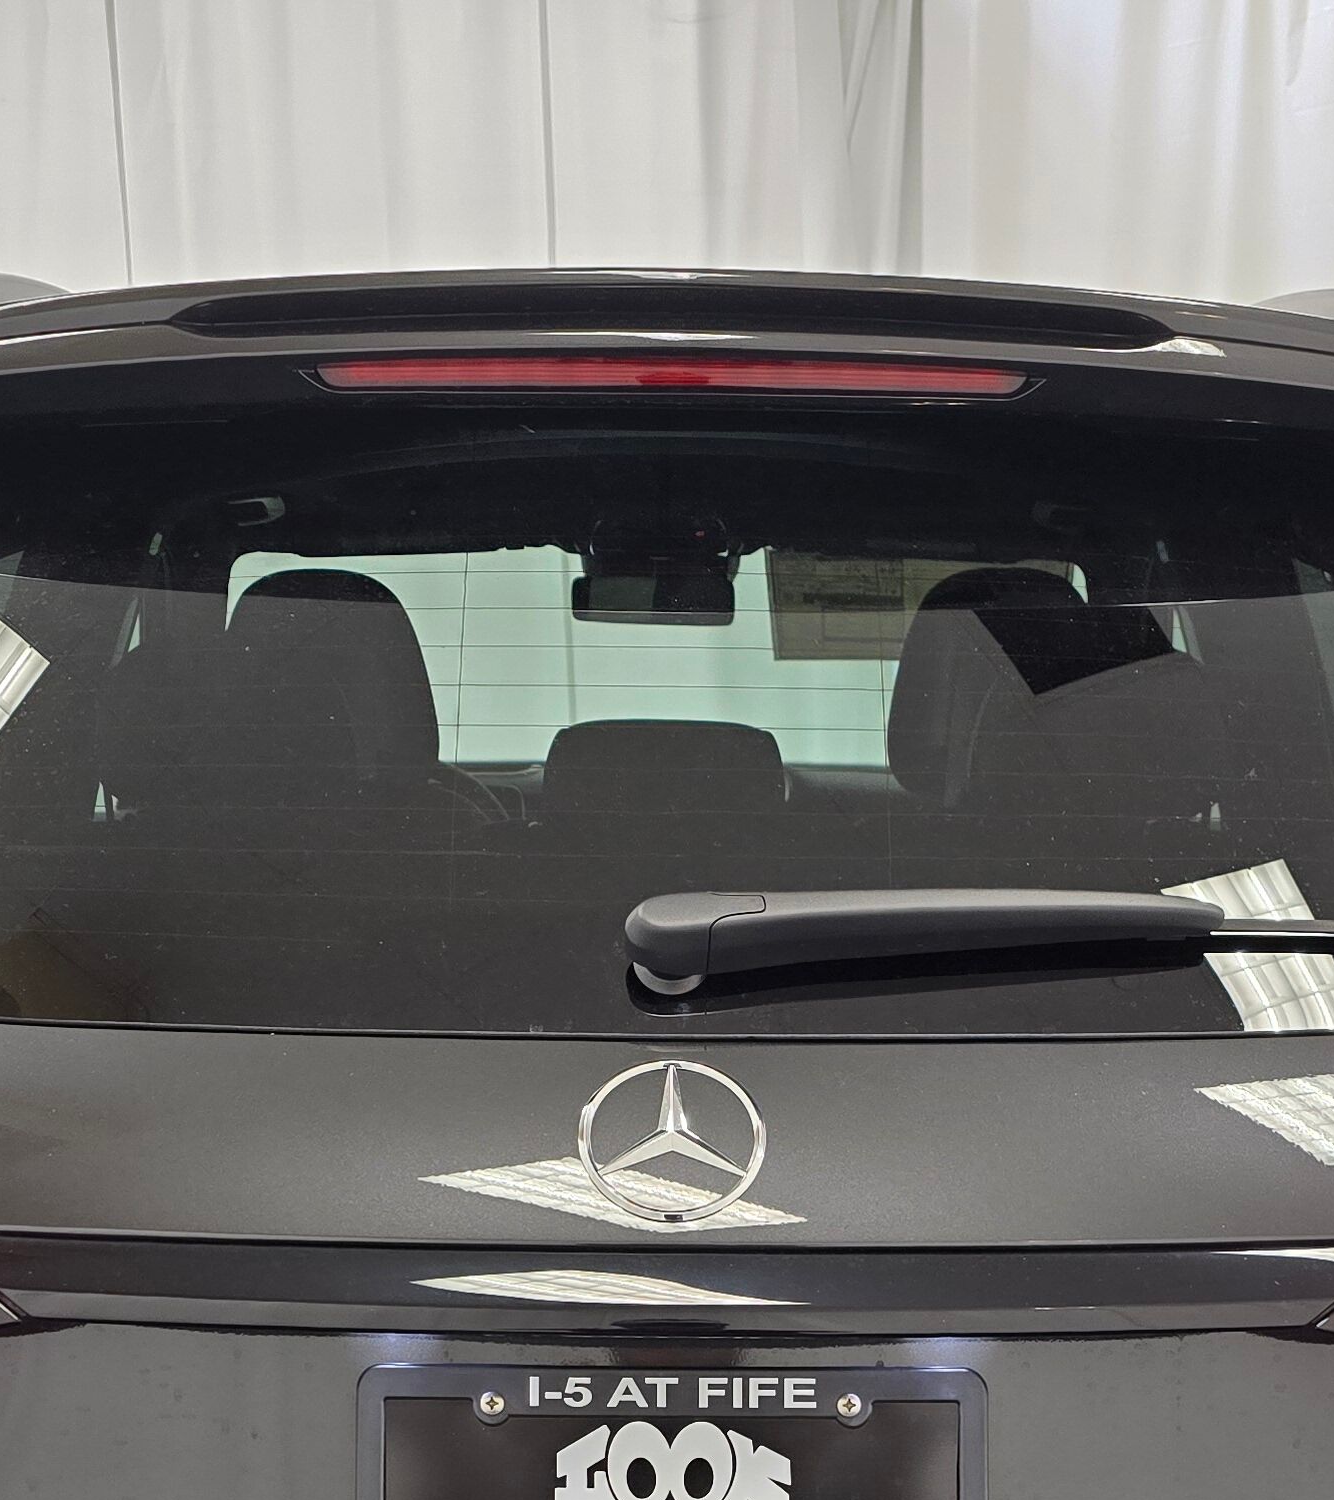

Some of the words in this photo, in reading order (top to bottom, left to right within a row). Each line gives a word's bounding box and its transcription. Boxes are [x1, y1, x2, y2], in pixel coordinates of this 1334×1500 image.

[528, 1375, 594, 1409] I-5
[606, 1376, 679, 1409] AT
[697, 1376, 819, 1409] FIFE
